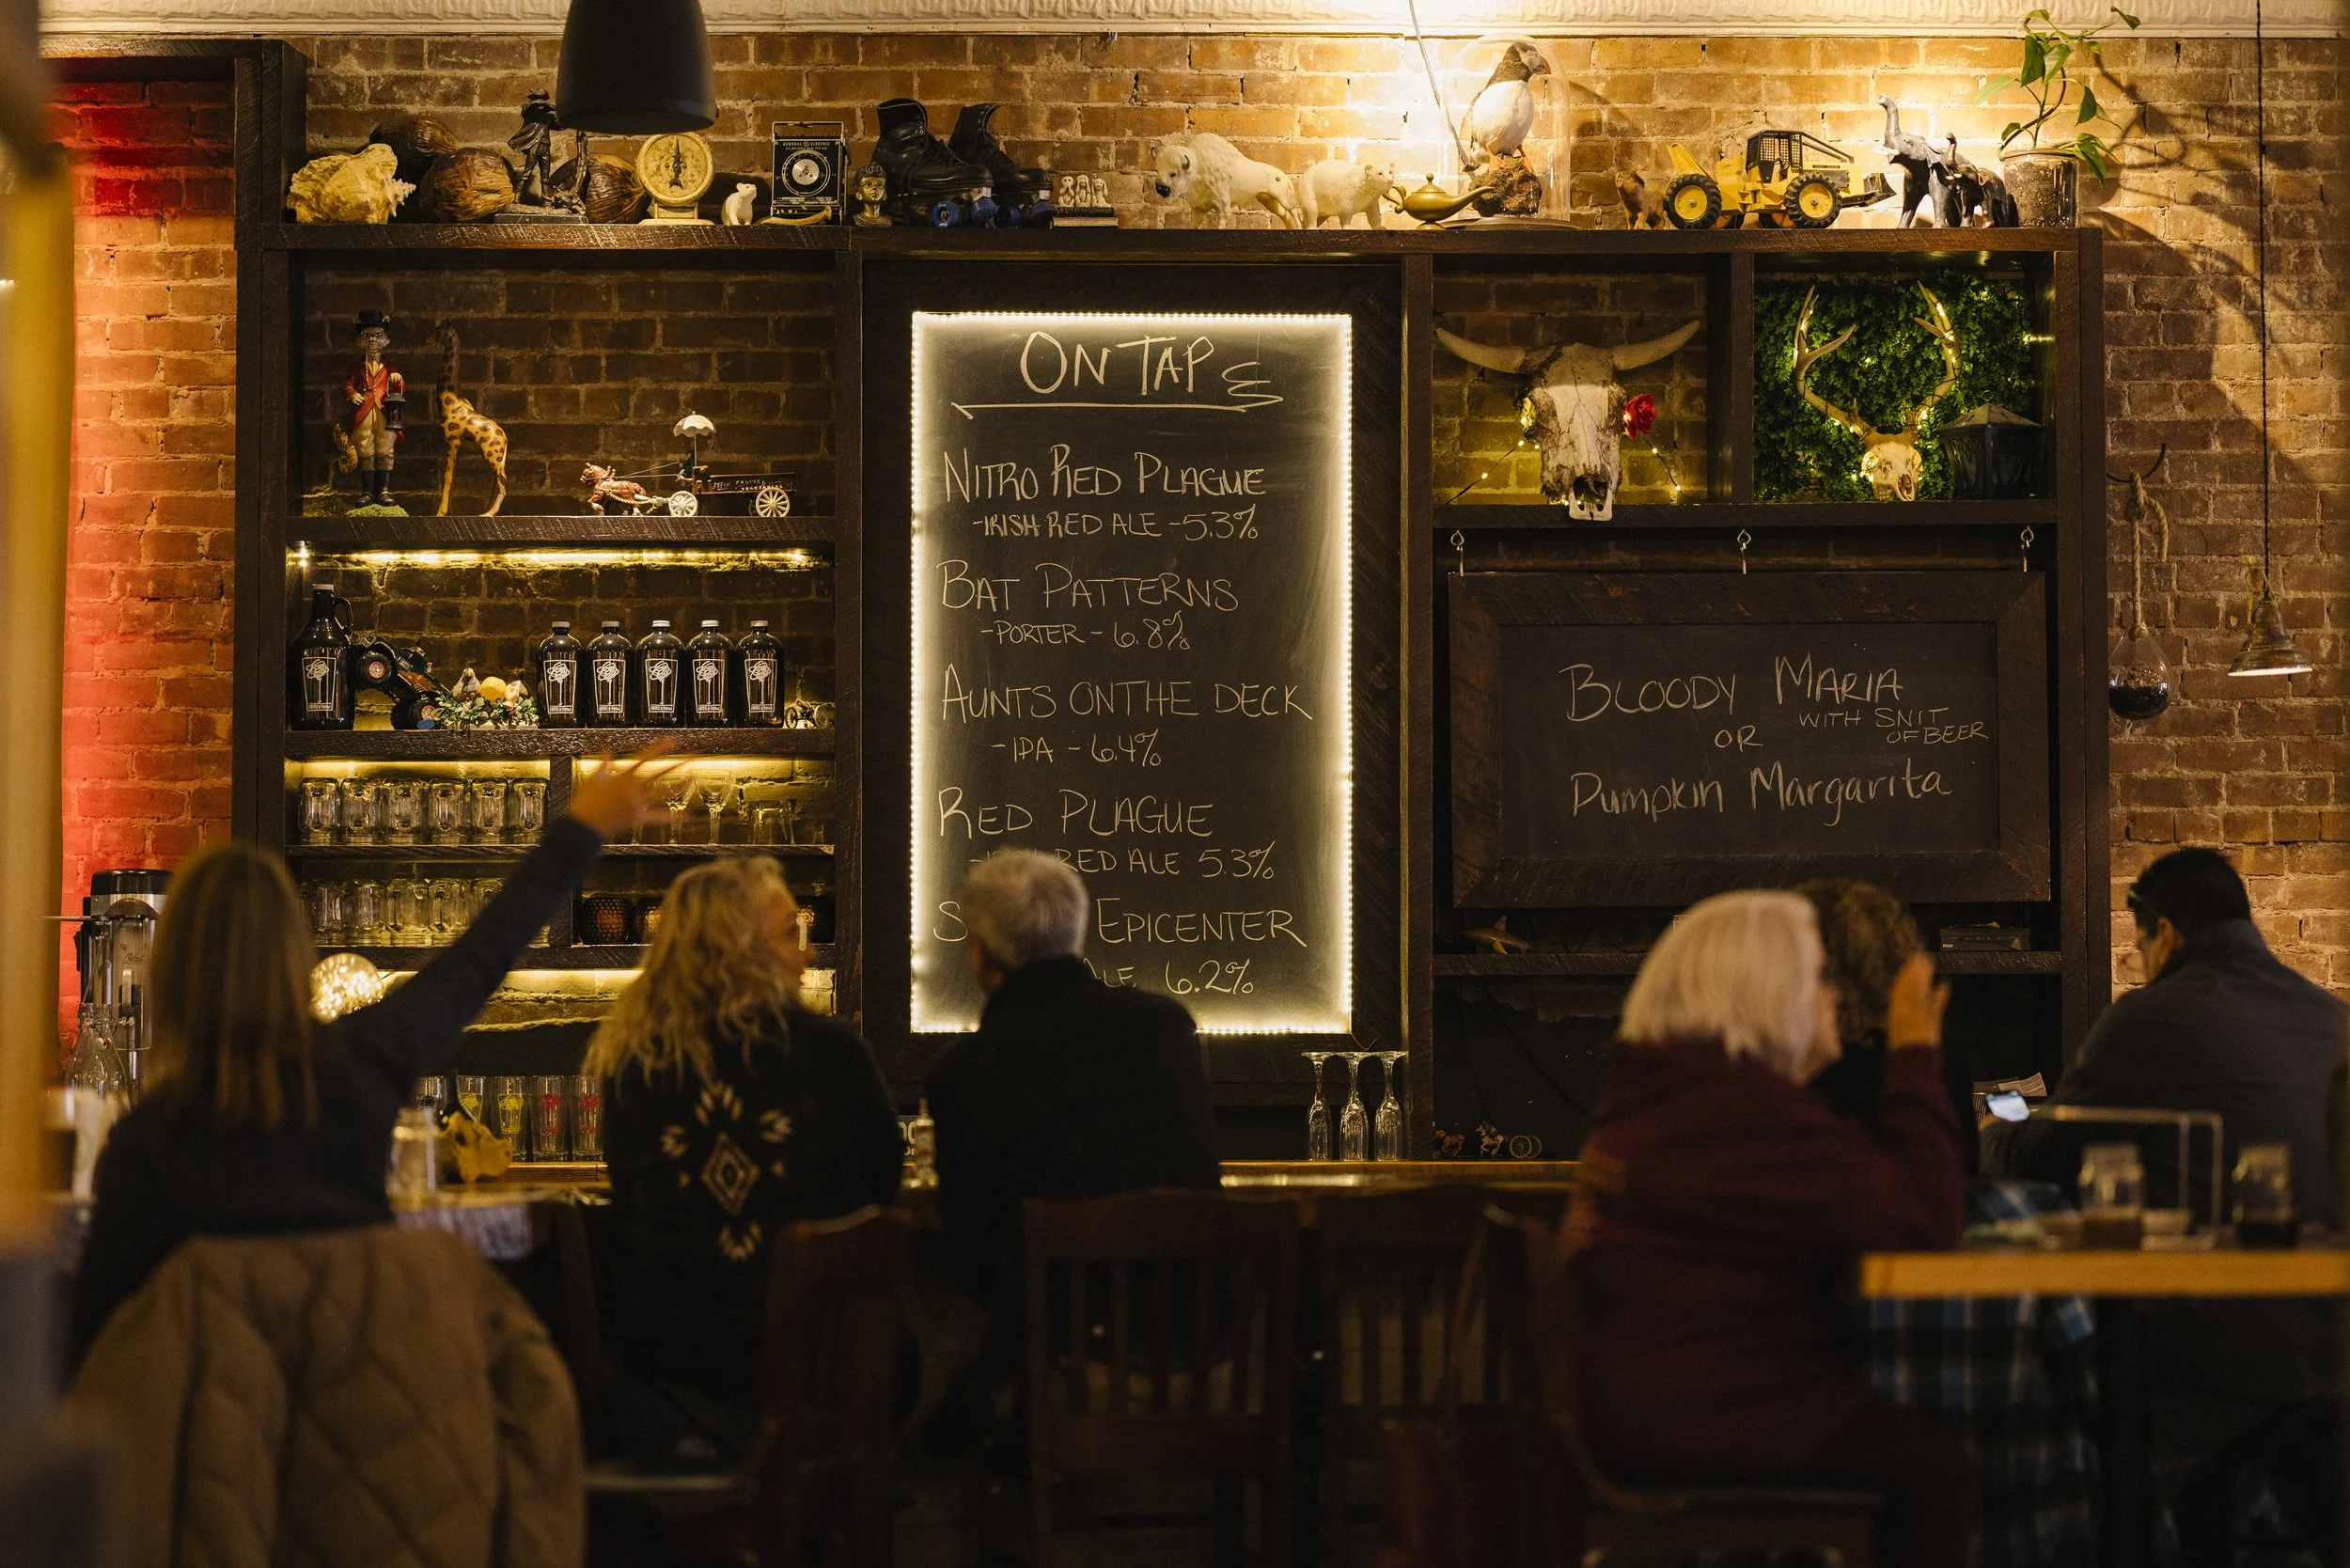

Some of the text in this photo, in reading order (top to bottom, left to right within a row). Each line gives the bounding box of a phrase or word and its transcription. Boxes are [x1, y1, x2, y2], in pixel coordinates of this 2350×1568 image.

[1020, 331, 1214, 396] ON TAP
[944, 444, 1267, 503] NITRO RED PLAGUE
[1047, 512, 1103, 538] RED
[1112, 512, 1162, 537] ALE
[937, 559, 1239, 612] BAT PATTERNS
[942, 664, 1057, 723] AUNTS
[1214, 682, 1312, 720] DECK
[1559, 650, 1904, 722] BLOODY MARIA
[1715, 725, 1763, 751] OR
[1799, 707, 1949, 730] WITH SNIT
[938, 787, 1214, 839] RED PLAGUE
[1571, 757, 1953, 827] Pumpkin Margarita
[1055, 848, 1117, 873] RED
[1130, 849, 1181, 875] ALE
[1198, 840, 1276, 879] 5.3%
[1097, 898, 1308, 948] EPICENTER
[1166, 959, 1255, 996] 6.2%
